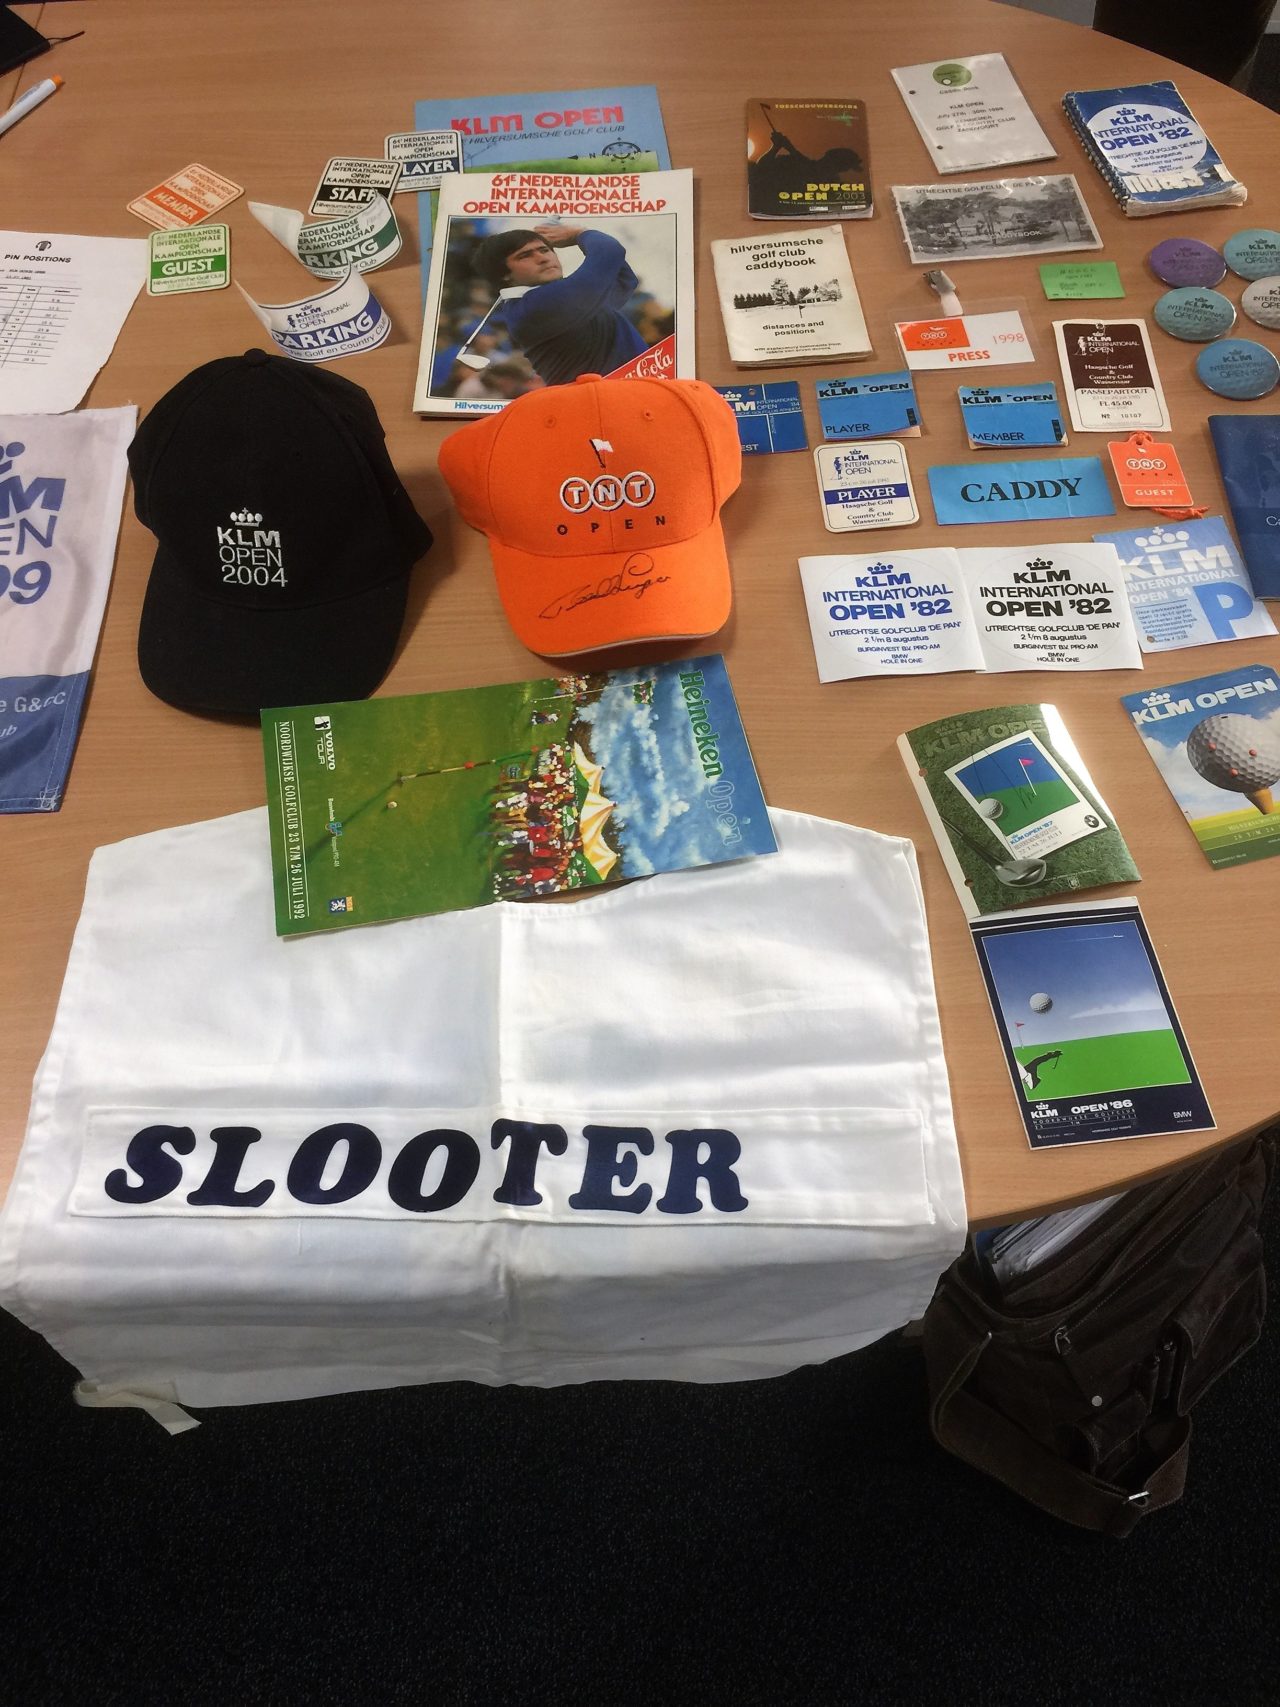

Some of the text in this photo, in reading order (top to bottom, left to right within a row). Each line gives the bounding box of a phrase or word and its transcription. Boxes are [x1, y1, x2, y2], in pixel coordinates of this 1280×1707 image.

[452, 106, 624, 136] KLM OPEN
[1094, 117, 1189, 138] NTERNATIONAL
[1110, 113, 1154, 126] KLM
[470, 125, 625, 145] HILVERSUMSCHE GOLF CLUB
[1100, 126, 1193, 151] OPEN '82
[402, 160, 455, 176] LAYER
[520, 175, 640, 188] NEDERLANDSE
[491, 188, 640, 200] INTERNATIONALE
[779, 192, 827, 201] OPEN
[464, 199, 666, 215] OPEN KAMPIOENSCHAP
[305, 239, 379, 268] RKING
[730, 238, 823, 255] hilversumsche
[752, 248, 806, 262] golf club
[162, 258, 215, 276] GUEST
[745, 257, 817, 271] caddybook
[272, 311, 374, 349] PARKING
[763, 322, 806, 331] distances
[774, 328, 815, 337] positions
[993, 332, 1024, 345] 1998
[948, 350, 991, 362] PRESS
[819, 383, 909, 397] KLM OPEN
[962, 394, 1053, 405] KLM OPEN
[825, 424, 870, 434] PLAYER
[973, 432, 1025, 441] MEMBER
[844, 459, 898, 468] INTERNATIONAL
[845, 467, 872, 475] OPEN
[1128, 460, 1164, 469] TNT
[564, 475, 651, 509] TNT
[838, 487, 897, 501] PLAYER
[960, 477, 1083, 503] CADDY
[557, 516, 666, 536] OPEN
[0, 515, 58, 555] EN
[217, 526, 281, 548] KLM
[220, 545, 282, 567] OPEN
[1120, 545, 1234, 582] KLM
[222, 564, 288, 587] 2004
[855, 573, 912, 588] KLM
[1013, 570, 1071, 584] KLM
[823, 584, 954, 603] INTERNATIONAL
[980, 582, 1114, 598] INTERNATIONAL
[1131, 591, 1169, 605] OPEN
[829, 599, 952, 621] OPEN '82
[986, 598, 1112, 617] OPEN '82
[1193, 581, 1254, 640] P
[829, 629, 880, 637] UTRECHTSE
[881, 626, 927, 635] GOLFCLUB
[1038, 624, 1084, 632] GOLFCLUB
[893, 635, 929, 644] augustus
[1050, 634, 1087, 642] augustus
[1132, 678, 1278, 725] KLM OPEN
[988, 719, 1046, 741] OPE
[279, 721, 295, 784] NOORDWIJKSE
[317, 737, 326, 765] TOUR
[325, 731, 336, 771] VOLVO
[679, 670, 743, 846] Heineken Open
[284, 785, 299, 830] GOLFCLUB
[288, 831, 300, 843] 23
[290, 864, 302, 874] 26
[291, 875, 304, 897] JULI
[293, 898, 306, 920] 1992
[1031, 1100, 1133, 1119] KLM OPEN '86
[1173, 1111, 1192, 1119] BMW
[104, 1118, 750, 1214] SLOOTER
